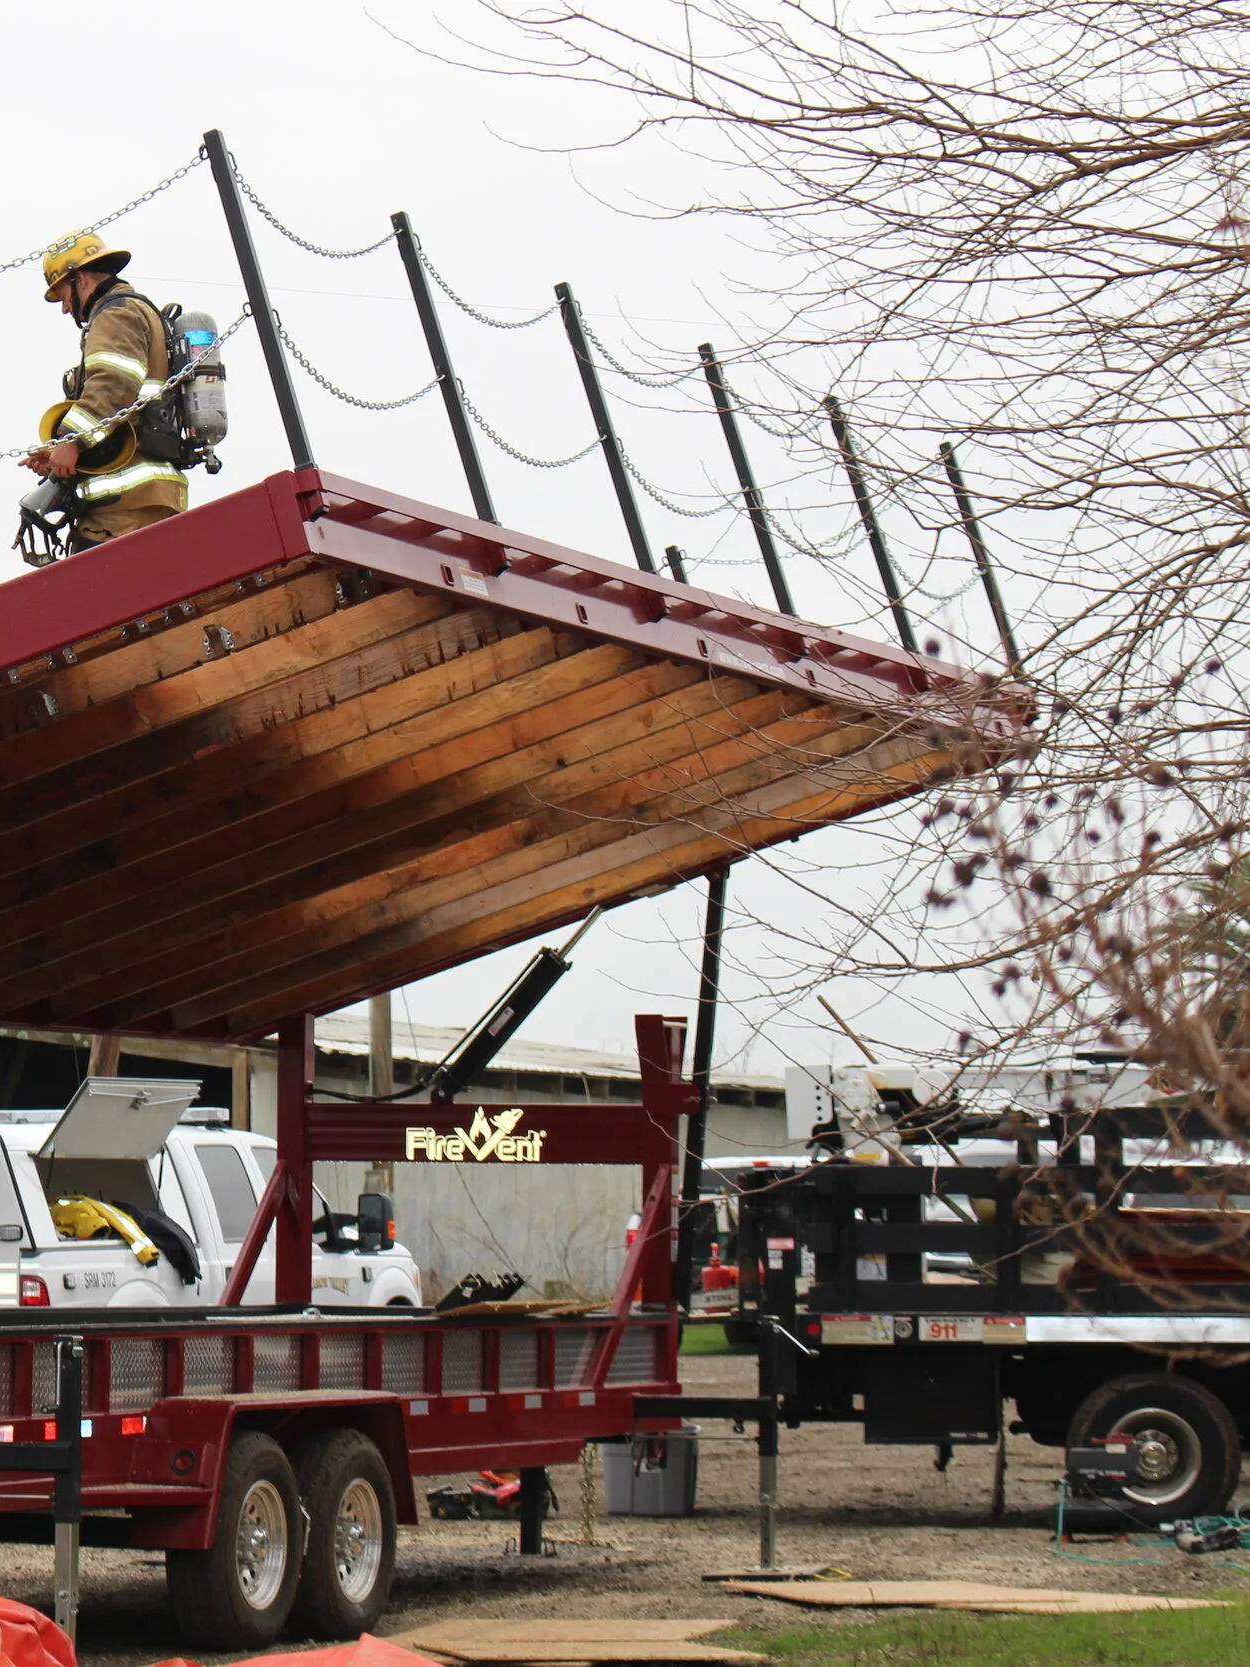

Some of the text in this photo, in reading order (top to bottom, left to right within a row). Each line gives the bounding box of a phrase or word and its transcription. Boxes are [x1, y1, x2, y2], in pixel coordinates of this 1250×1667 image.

[405, 1118, 543, 1162] FireVent
[84, 1271, 99, 1289] SRM
[930, 1322, 958, 1339] 911
